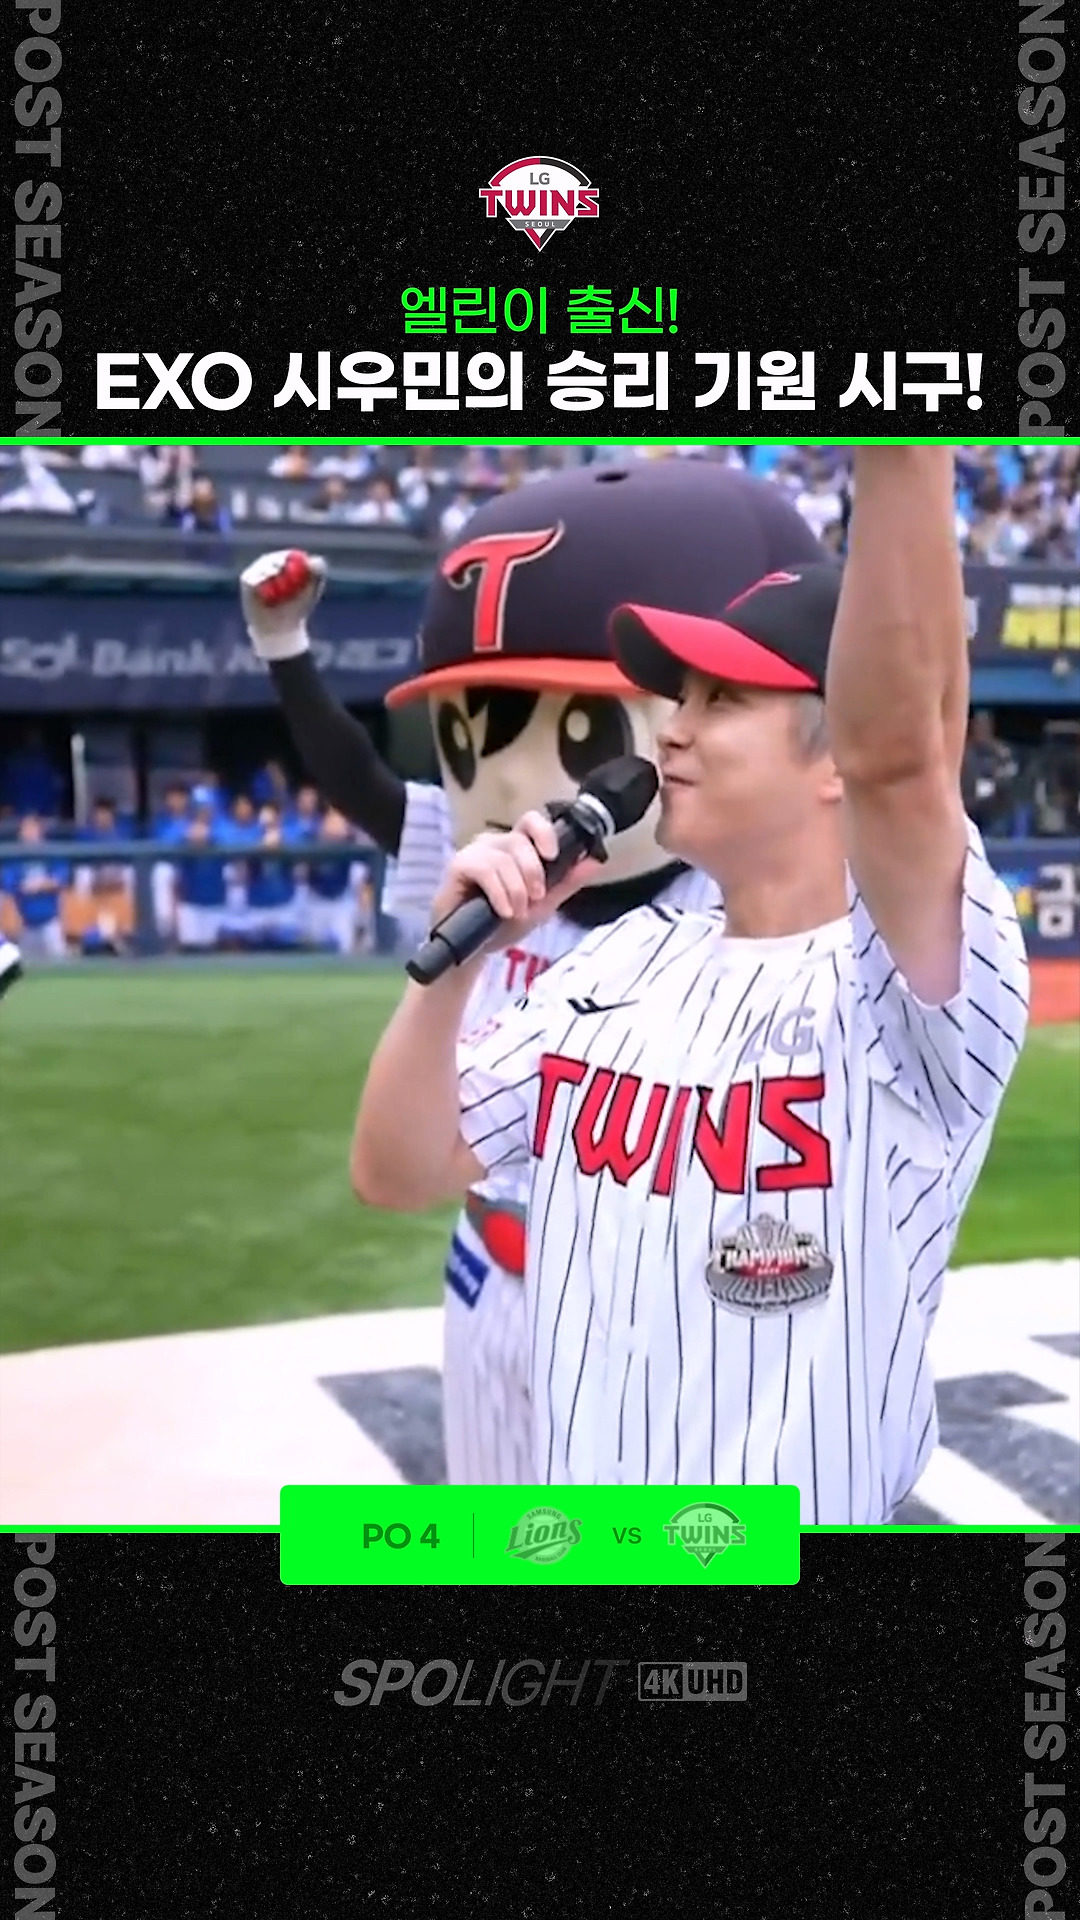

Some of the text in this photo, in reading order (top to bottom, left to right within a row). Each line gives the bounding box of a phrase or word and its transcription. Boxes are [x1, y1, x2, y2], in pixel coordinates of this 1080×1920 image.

[441, 520, 565, 652] T
[743, 1006, 816, 1064] LG
[533, 1053, 832, 1196] TWINS
